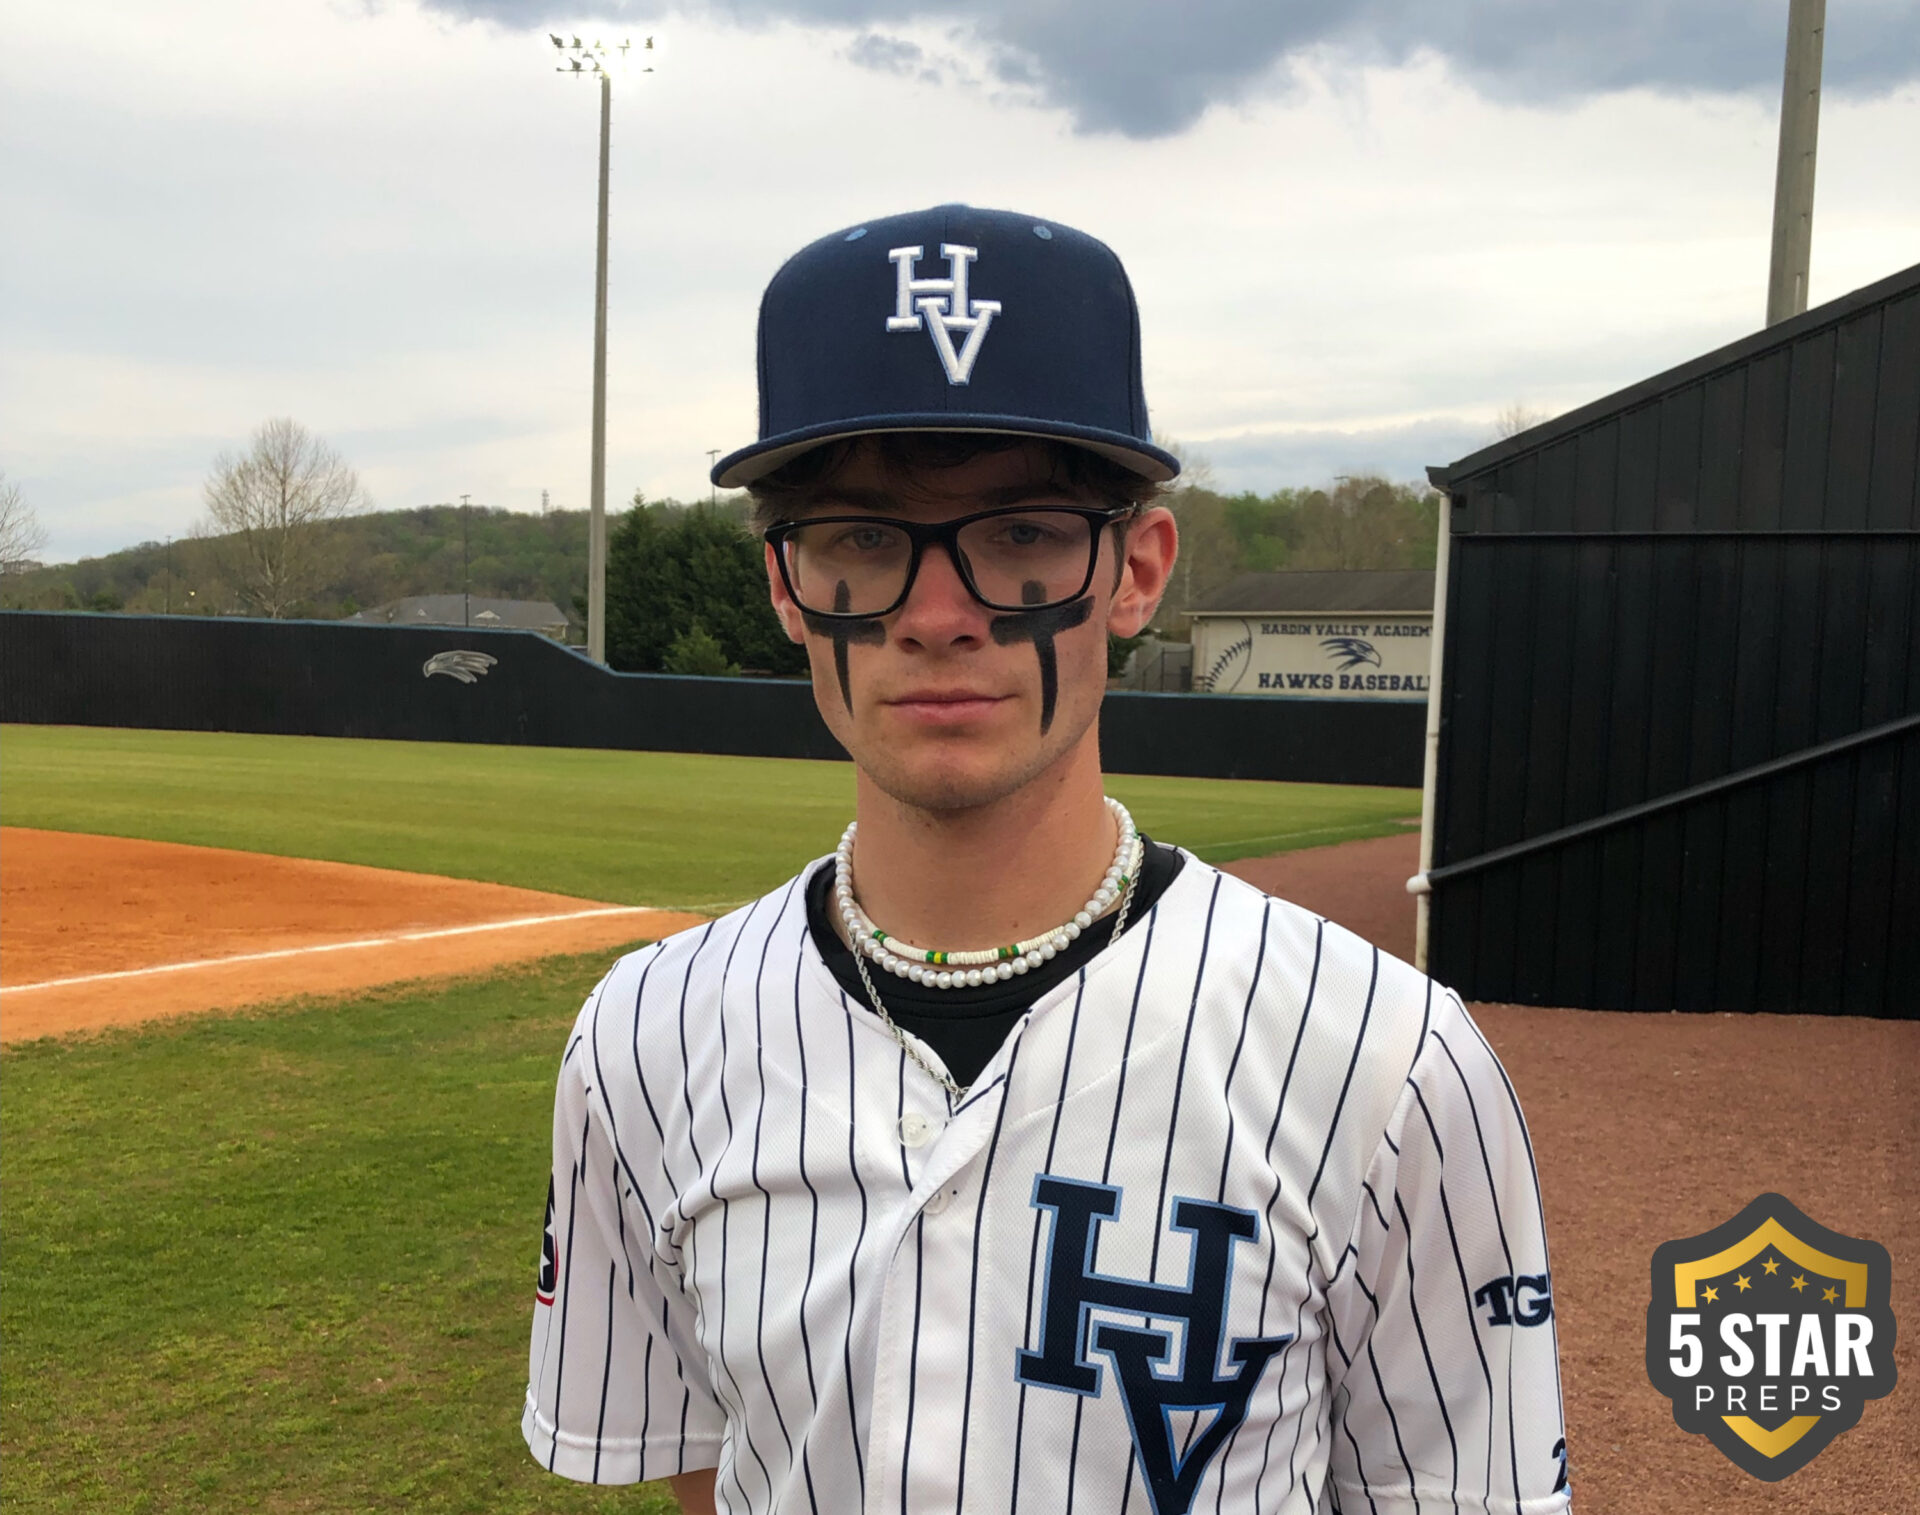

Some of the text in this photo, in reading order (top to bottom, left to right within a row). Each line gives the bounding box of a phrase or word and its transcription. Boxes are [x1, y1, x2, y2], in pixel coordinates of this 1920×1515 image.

[1261, 623, 1433, 637] HARDIN VALLEY ACADEM
[1258, 673, 1430, 691] HAWKS BASEBAL
